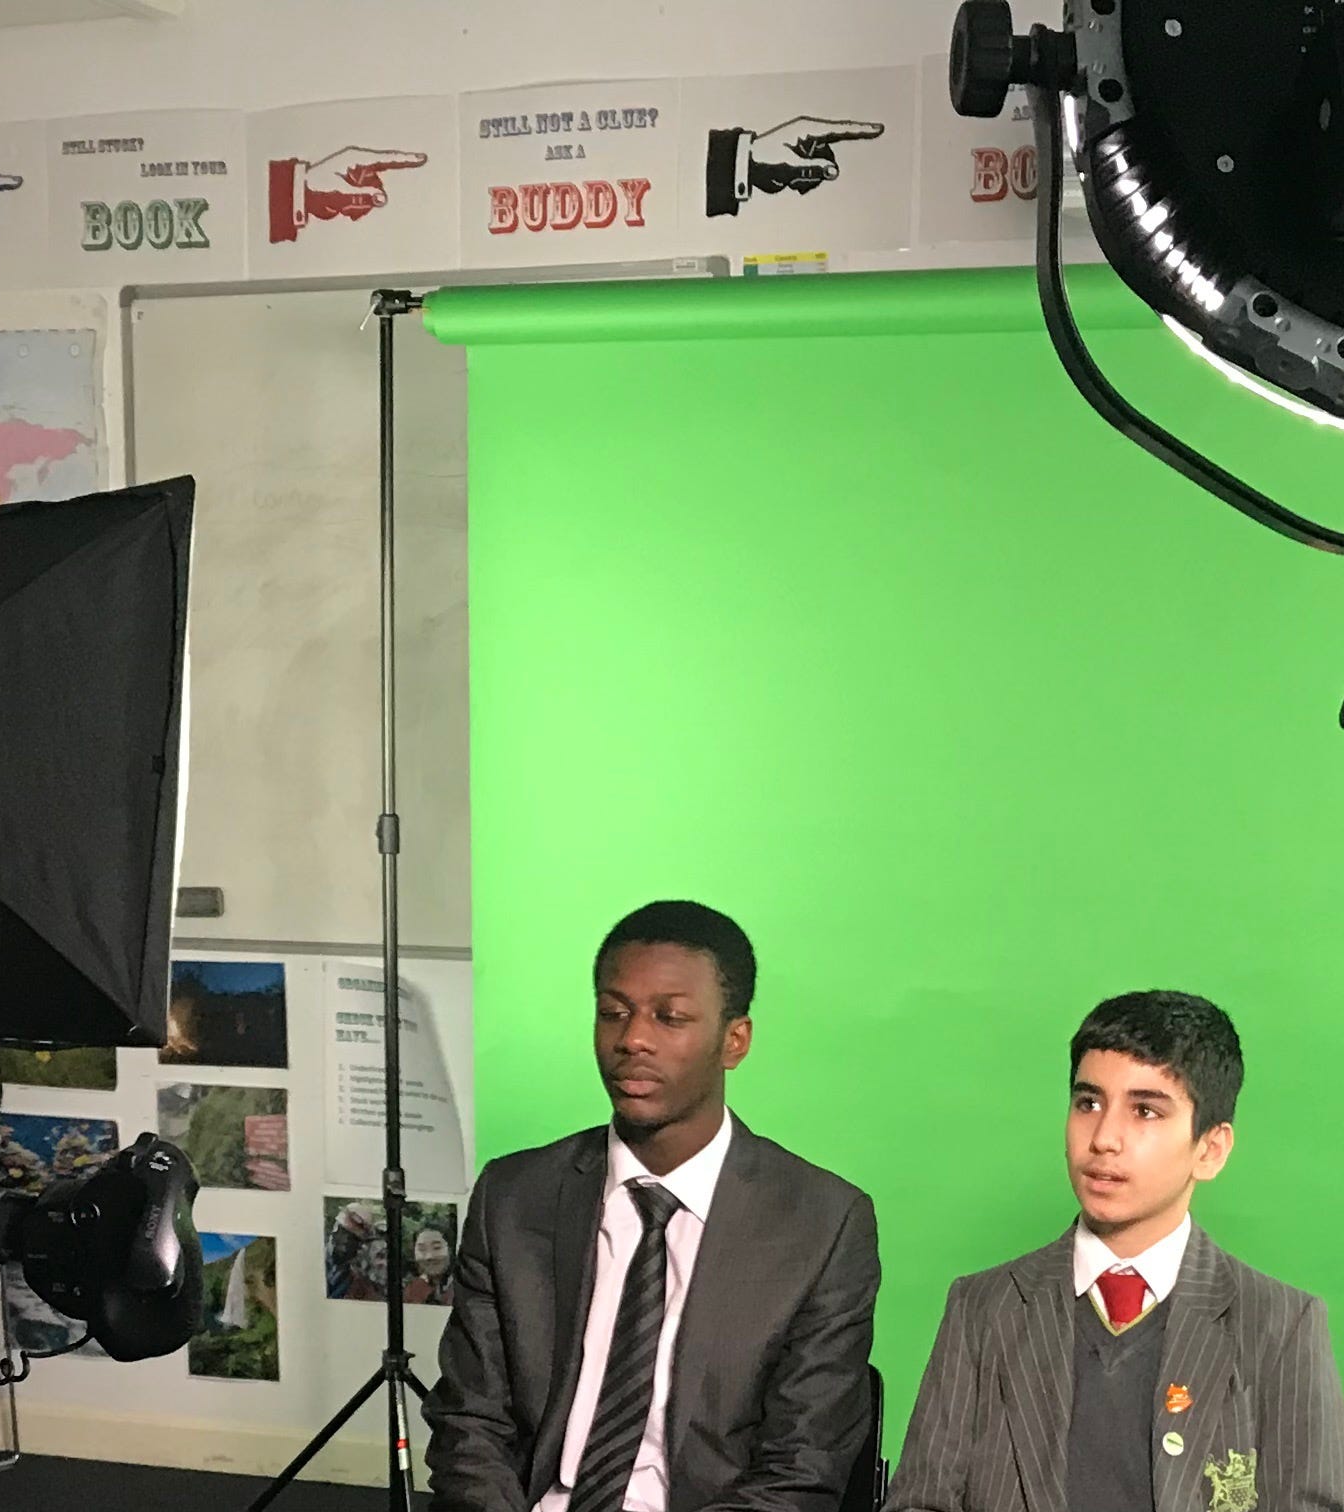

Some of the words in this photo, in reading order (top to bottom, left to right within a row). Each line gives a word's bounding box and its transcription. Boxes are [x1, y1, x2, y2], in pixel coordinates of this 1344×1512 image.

[480, 115, 532, 139] STILL
[535, 111, 574, 134] NOT
[578, 111, 592, 131] A
[595, 108, 659, 130] CLUE?
[1012, 105, 1032, 121] AS
[62, 140, 96, 156] STILL
[545, 144, 573, 161] ASK
[575, 144, 586, 159] A
[141, 163, 173, 178] LOOK
[175, 161, 189, 176] IN
[191, 161, 227, 176] YOUR
[971, 145, 1037, 202] BO
[488, 178, 652, 235] BUDDY
[81, 198, 210, 252] BOOK
